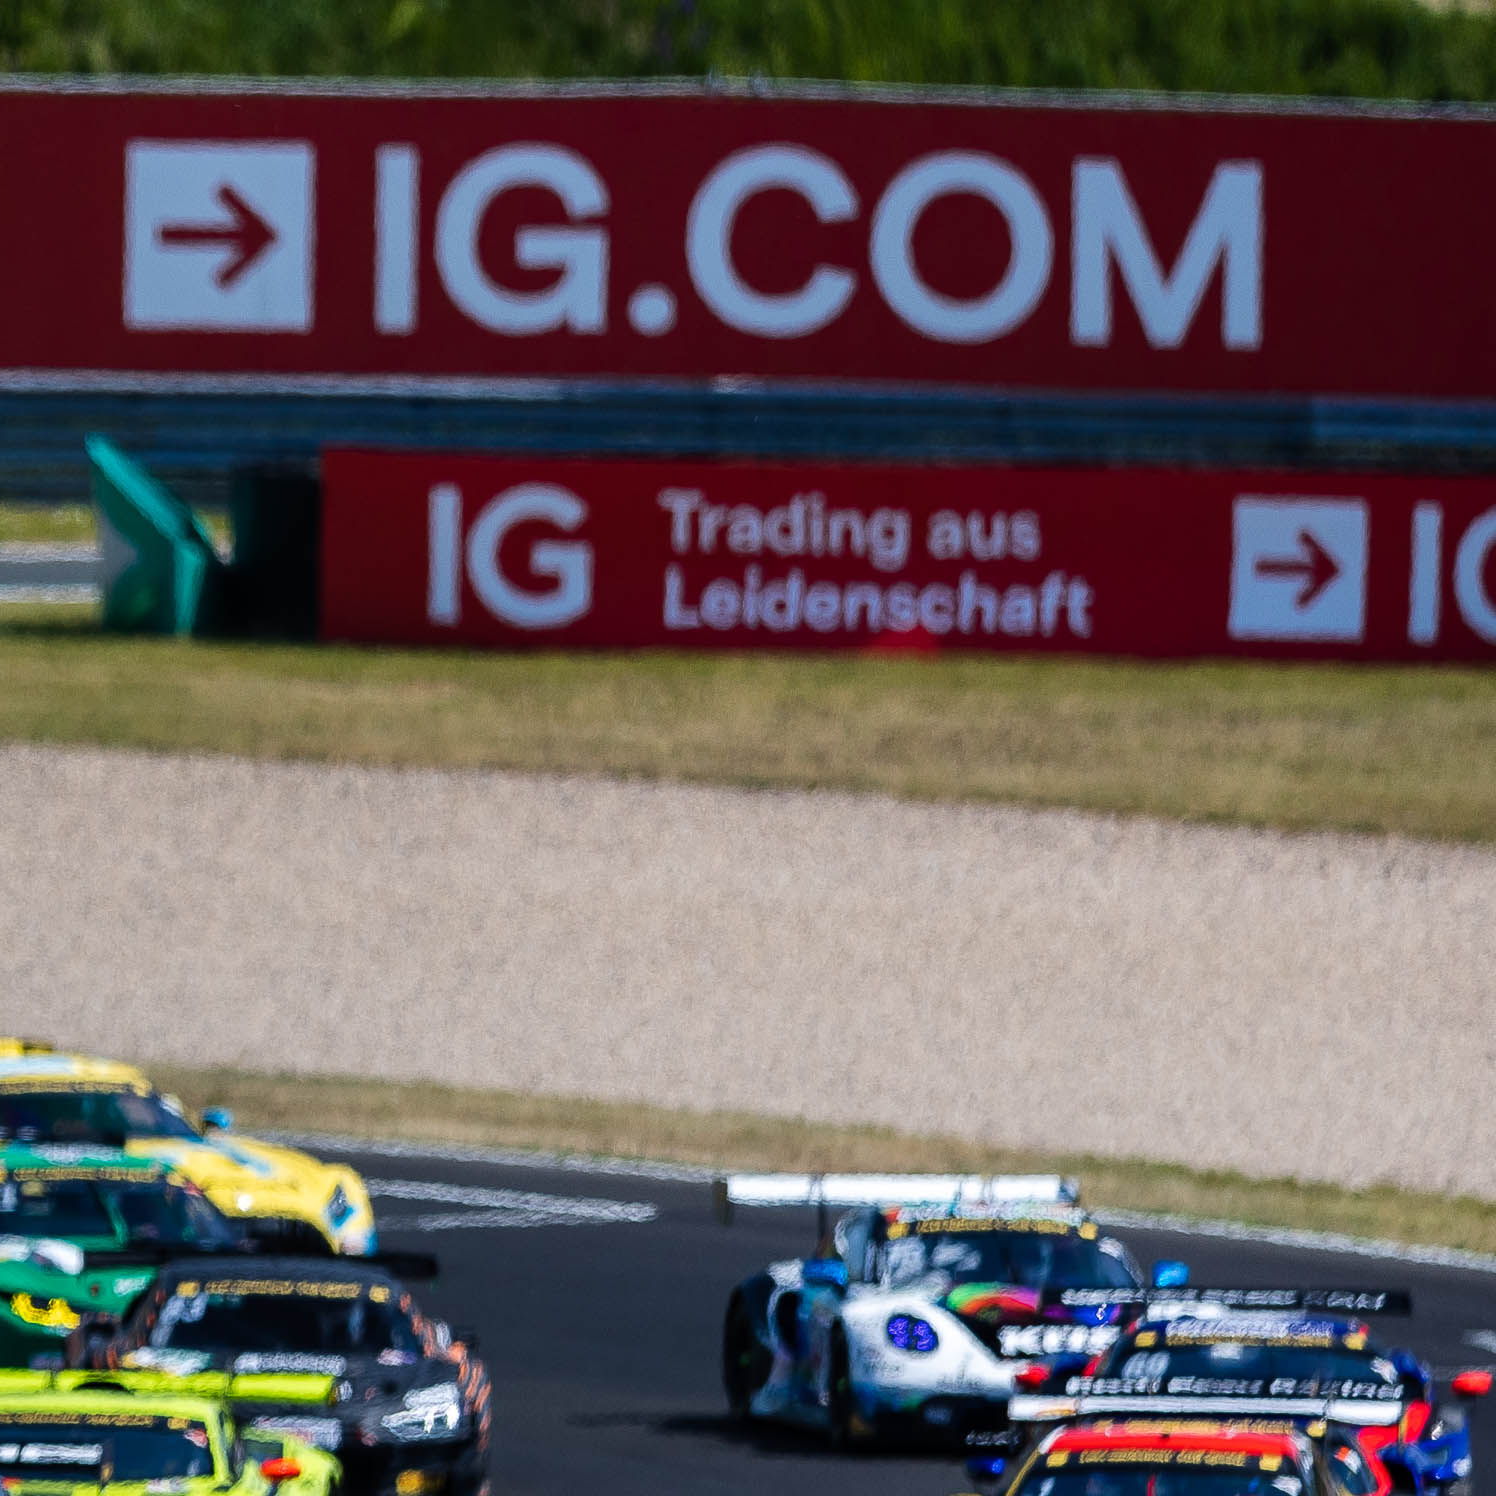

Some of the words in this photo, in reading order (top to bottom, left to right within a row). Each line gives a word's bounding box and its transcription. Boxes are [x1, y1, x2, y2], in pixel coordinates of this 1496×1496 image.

[379, 149, 1262, 346] IG.COM
[428, 483, 592, 628] IG
[661, 489, 909, 570] Trading
[928, 504, 1040, 558] aus
[662, 569, 1092, 637] Leidenschaft
